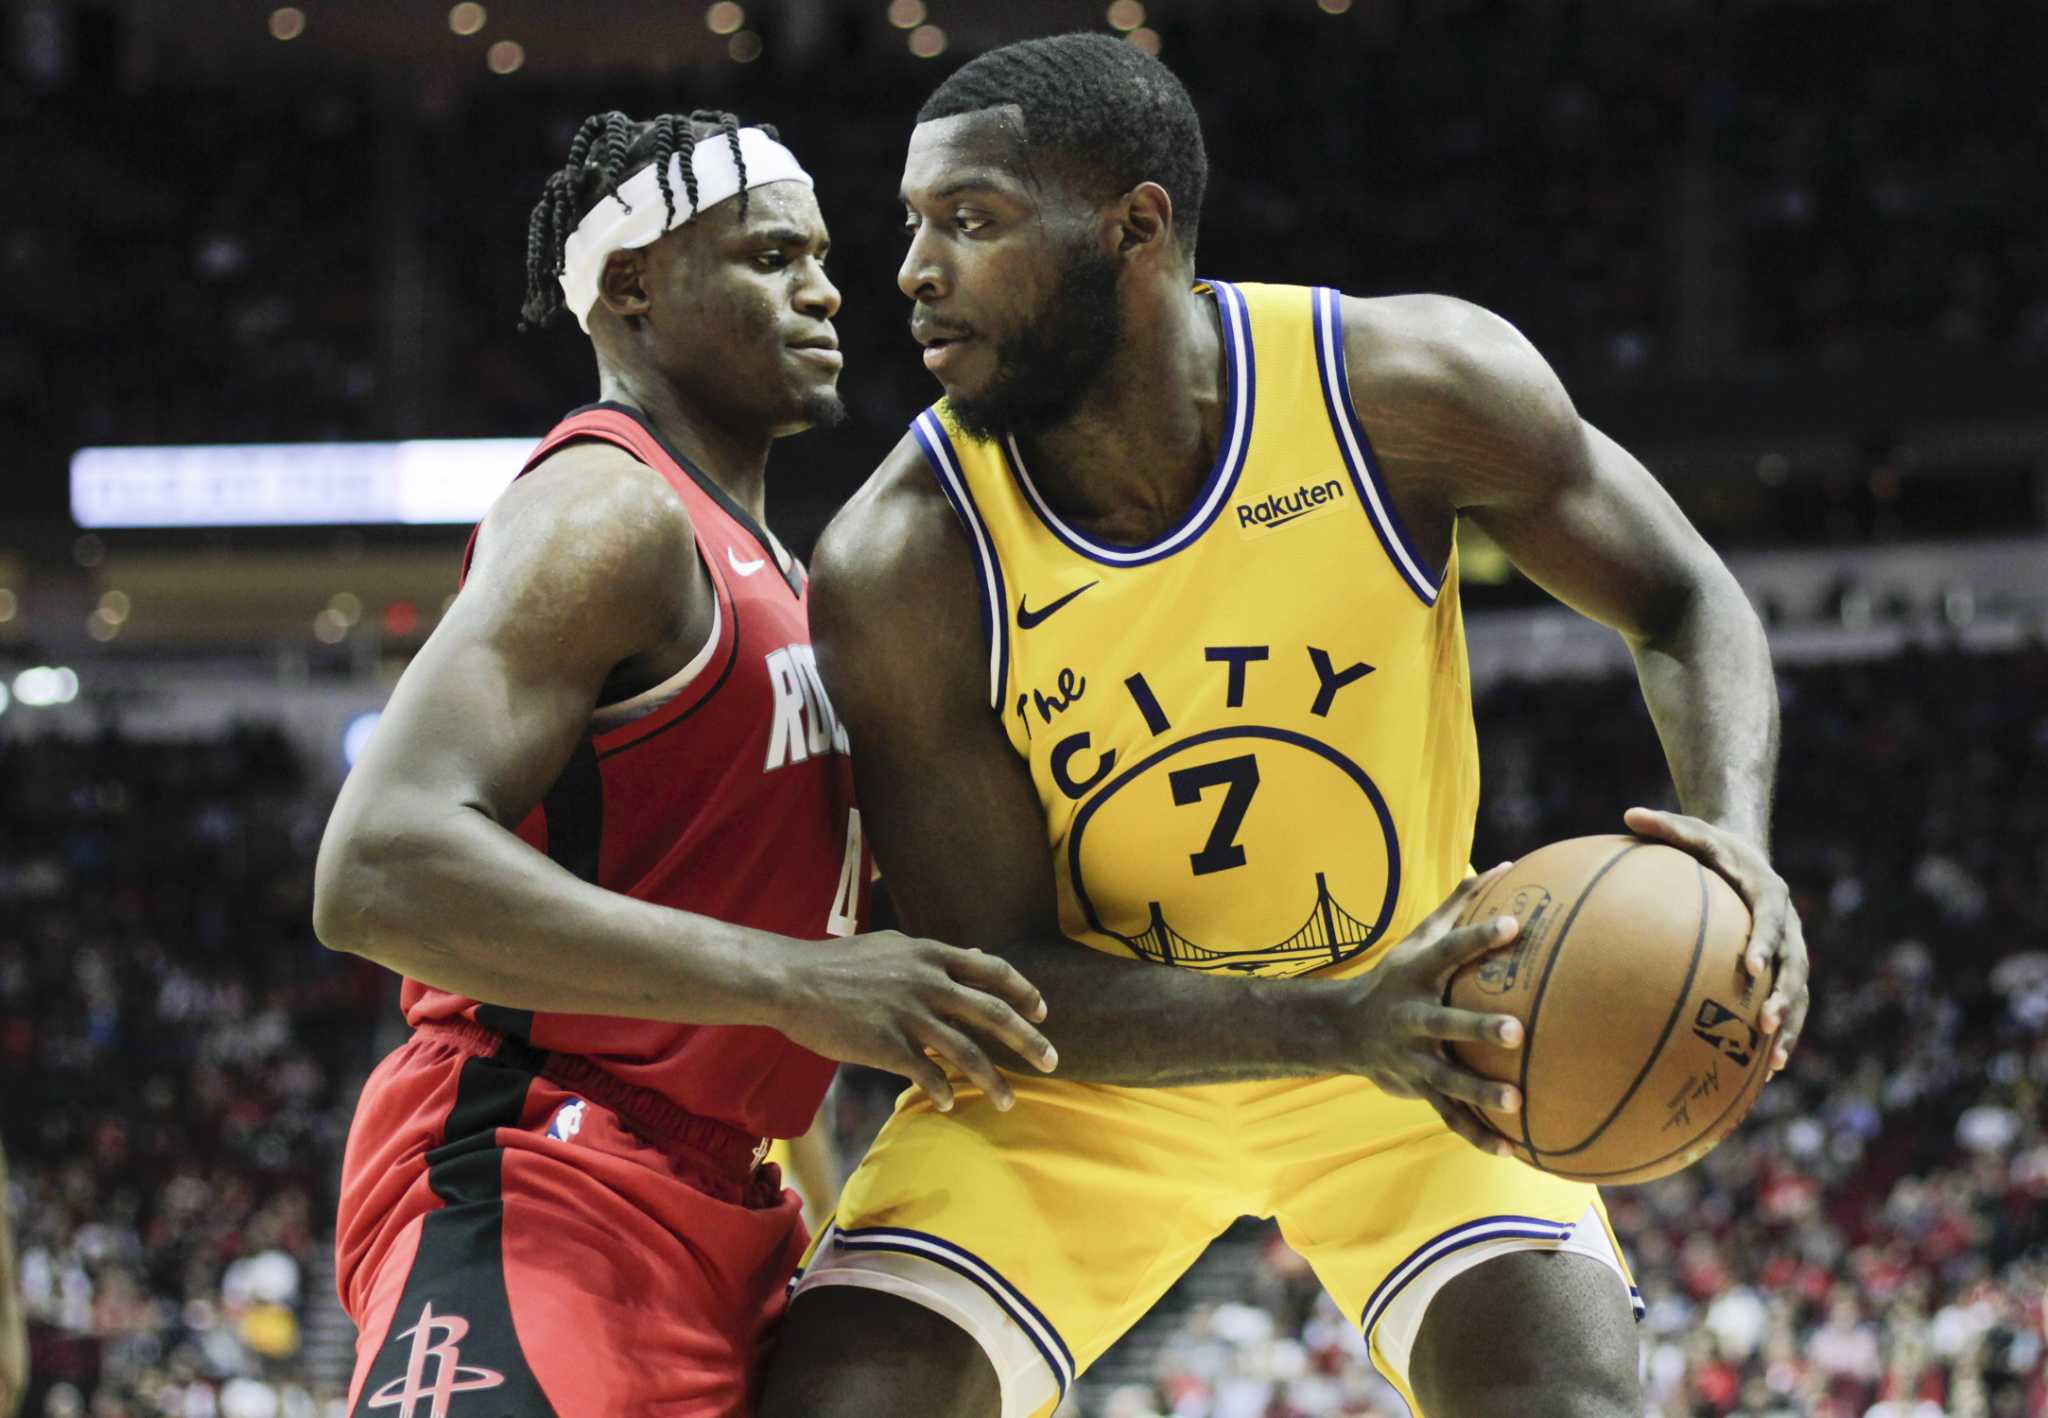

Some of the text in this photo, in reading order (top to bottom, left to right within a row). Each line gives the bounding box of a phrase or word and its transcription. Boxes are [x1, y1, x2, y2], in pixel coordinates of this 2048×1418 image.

[1237, 480, 1344, 528] Rakuten
[1016, 667, 1086, 740] The
[1050, 645, 1377, 800] CITY
[826, 807, 861, 937] 4
[1168, 753, 1260, 876] 7
